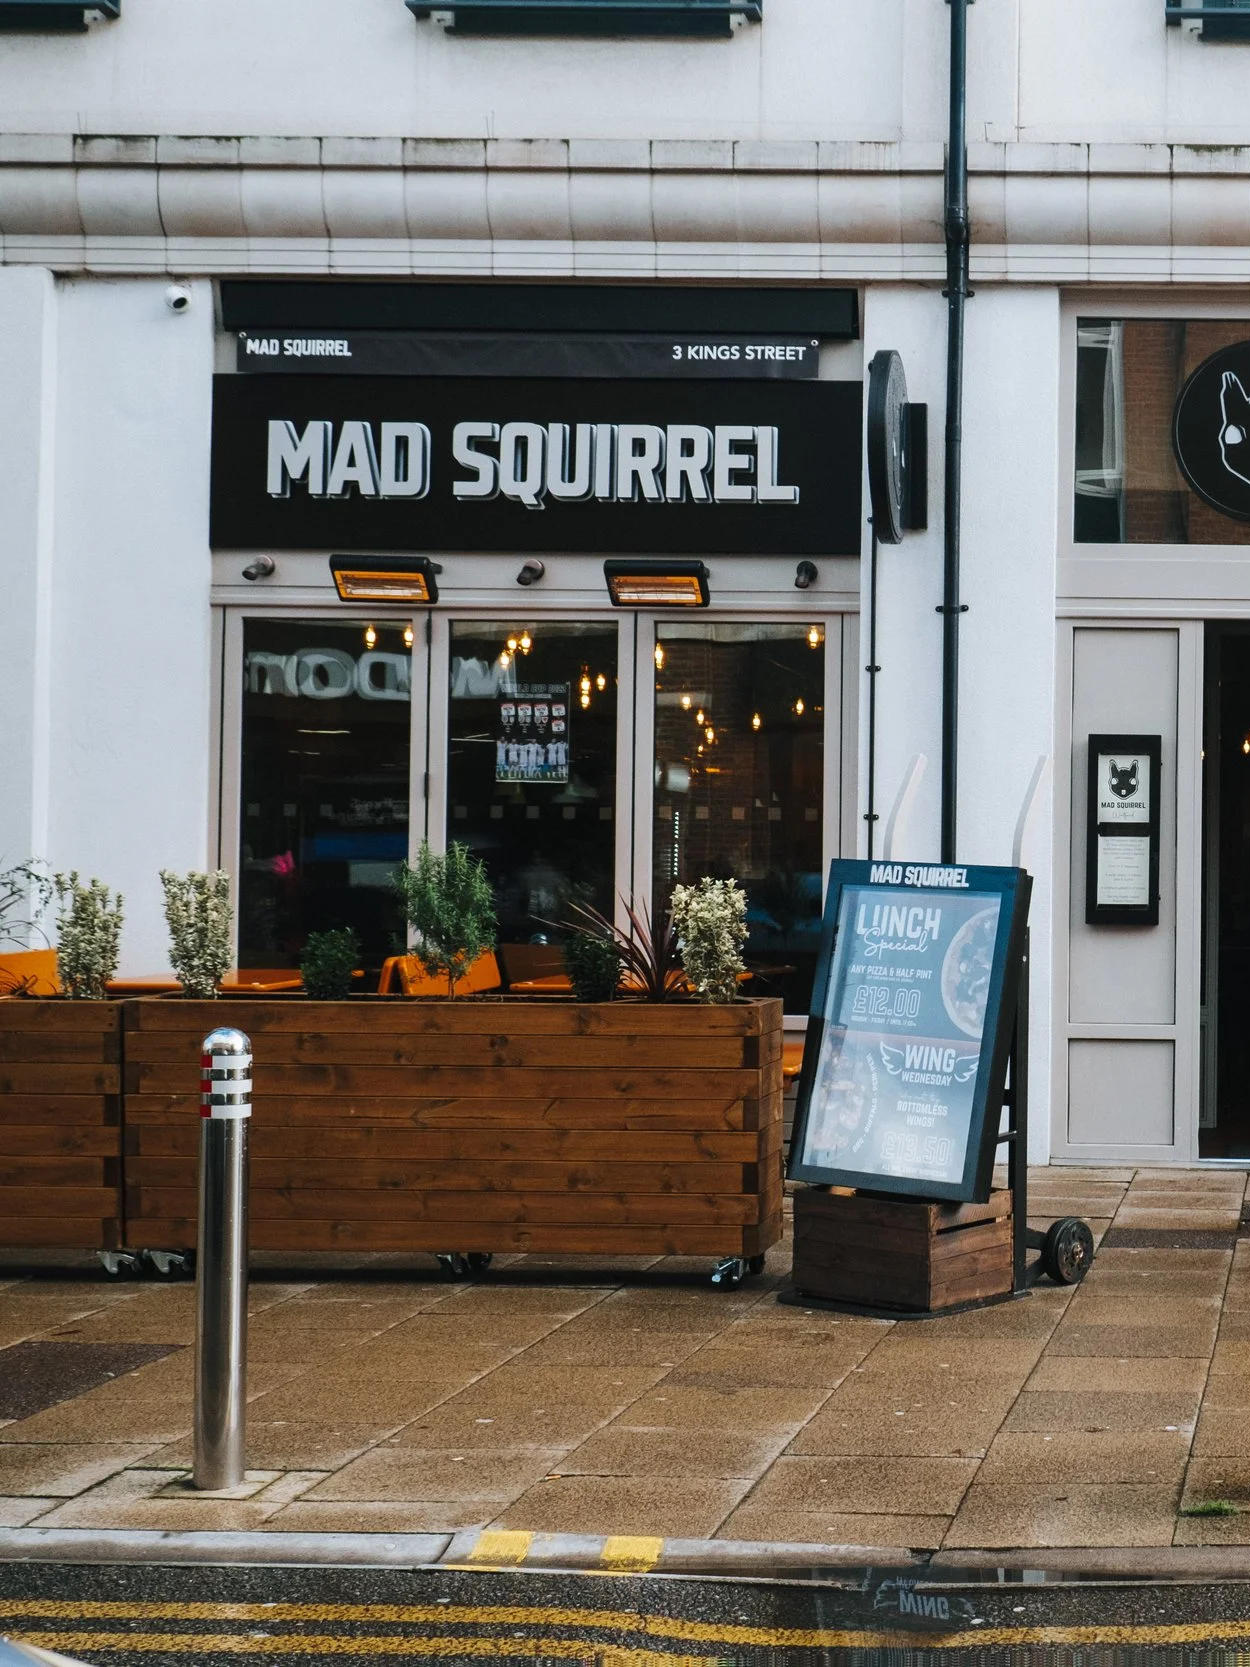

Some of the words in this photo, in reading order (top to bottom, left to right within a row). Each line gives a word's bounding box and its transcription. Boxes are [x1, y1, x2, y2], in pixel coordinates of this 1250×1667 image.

[246, 337, 279, 356] MAD
[283, 338, 352, 358] SQUIRREL
[672, 345, 683, 361] 3
[687, 345, 741, 361] KINGS
[744, 346, 806, 362] STREET
[266, 419, 431, 500] MAD
[452, 420, 800, 511] SQUIRREL
[1101, 801, 1115, 809] MAD
[870, 864, 903, 884] MAD
[904, 866, 970, 888] SQUIRREL
[857, 903, 942, 940] LUNCH
[863, 927, 928, 960] Special
[850, 964, 867, 974] ANY
[867, 966, 888, 977] PIZZA
[889, 968, 894, 976] &
[896, 968, 914, 978] HALF
[915, 970, 933, 980] PINT
[852, 985, 921, 1018] £12.00
[905, 1044, 956, 1072] WING
[902, 1071, 952, 1086] WEDNESDAY
[897, 1101, 948, 1116] BOTTOMLESS
[907, 1116, 935, 1128] WINGS!
[880, 1131, 953, 1166] £13.50
